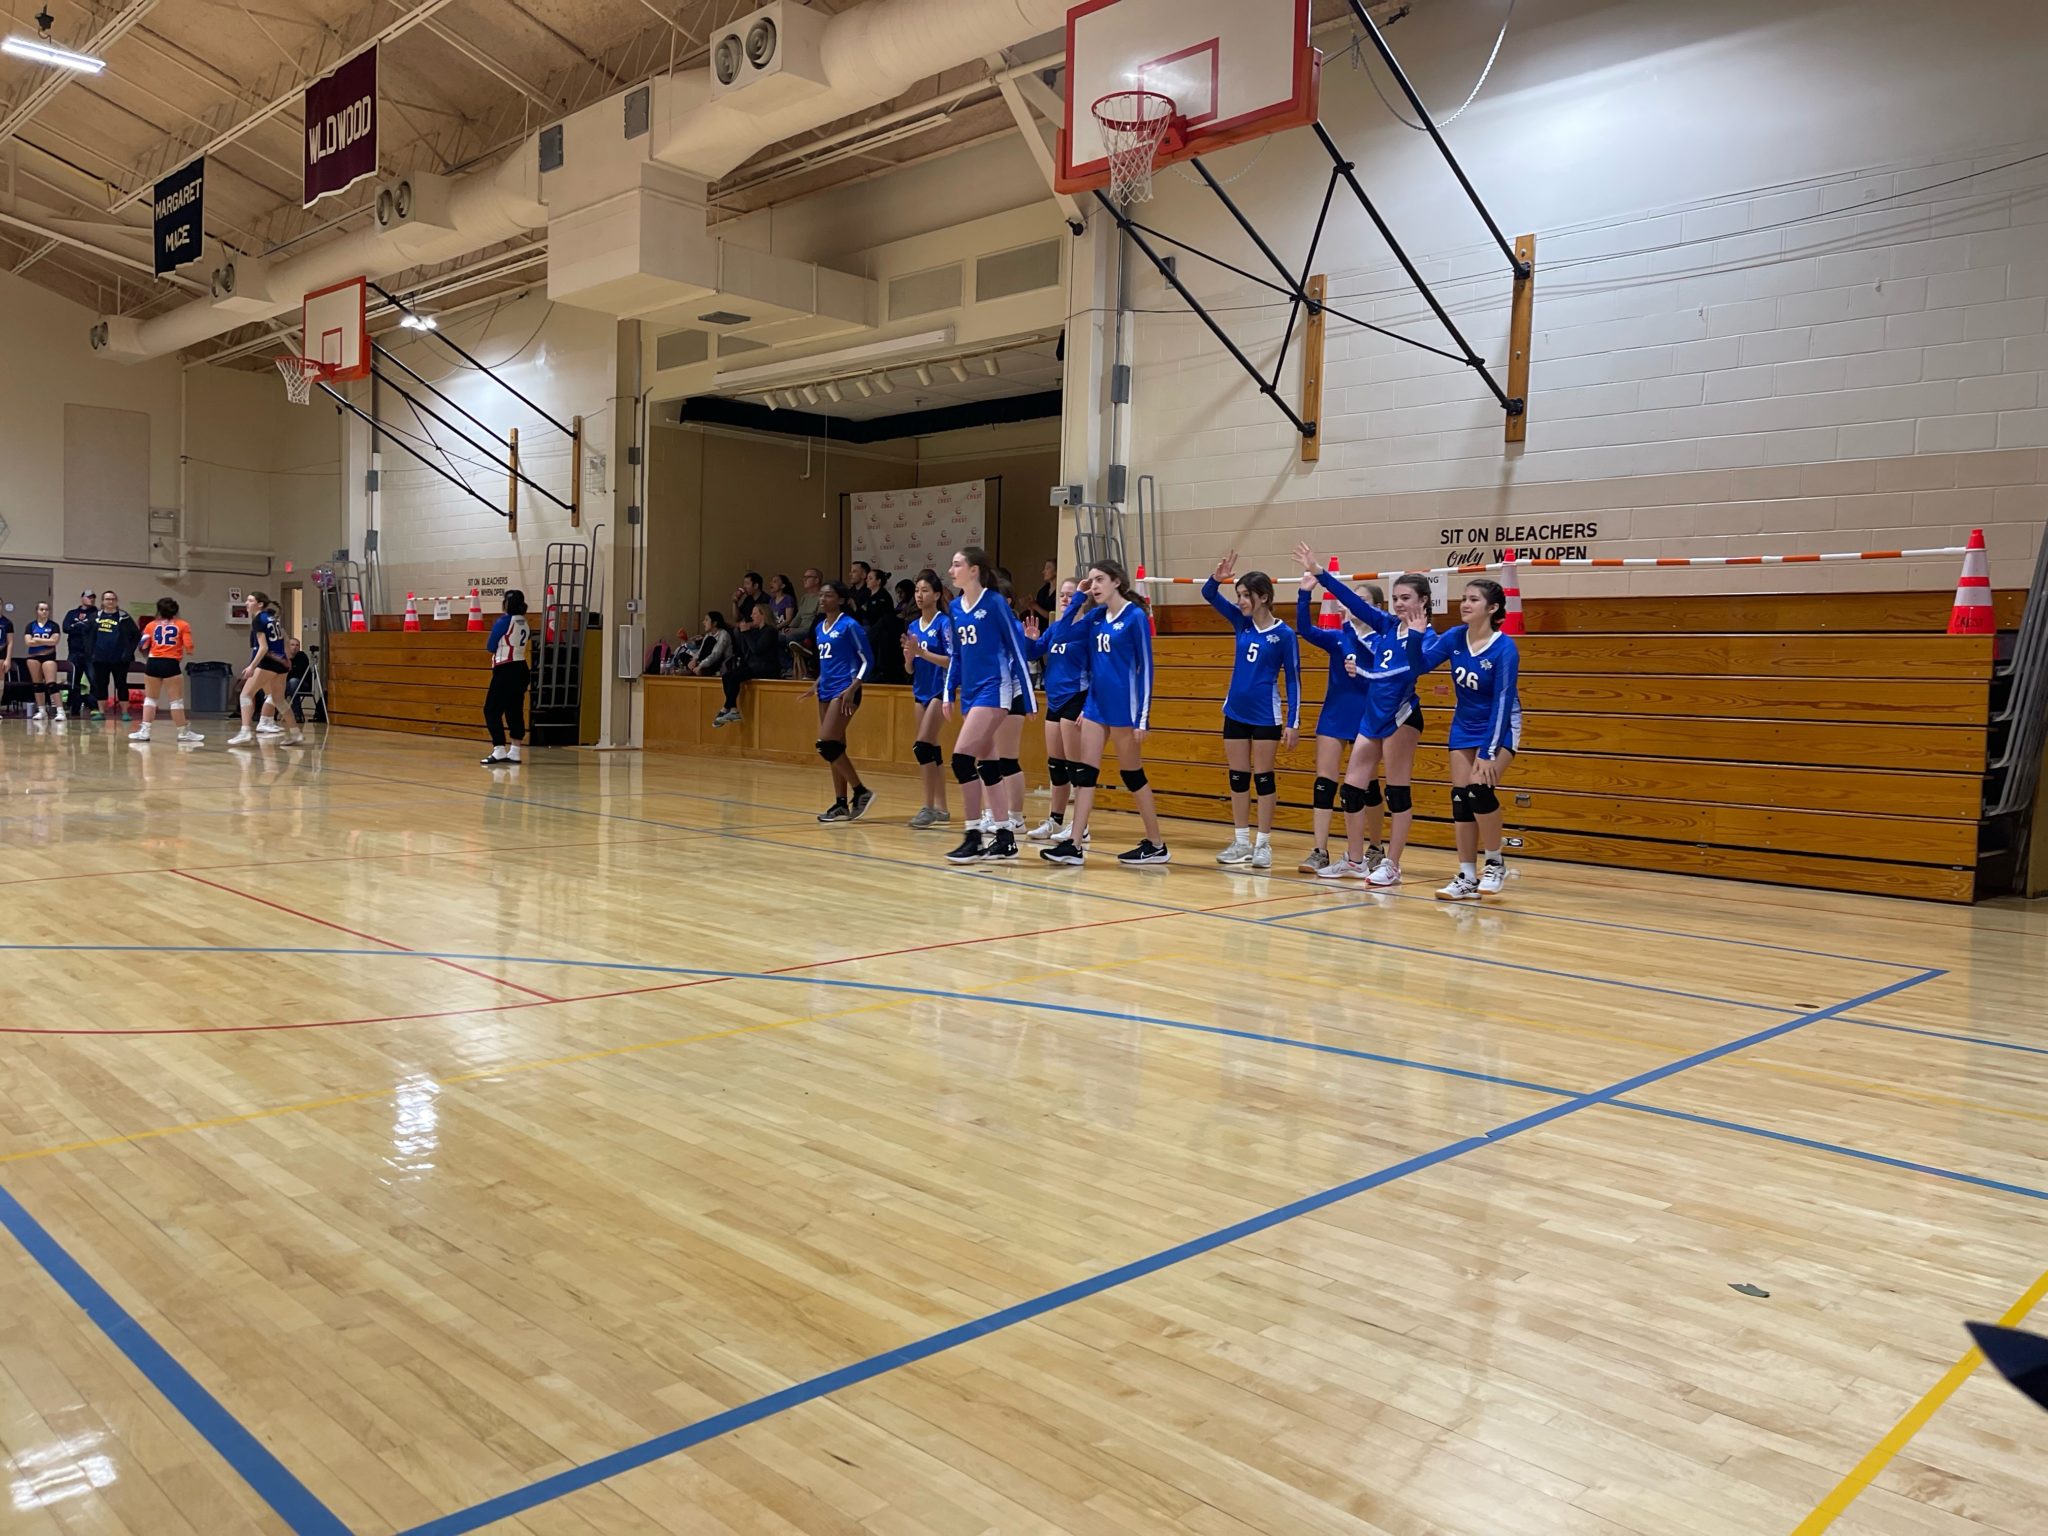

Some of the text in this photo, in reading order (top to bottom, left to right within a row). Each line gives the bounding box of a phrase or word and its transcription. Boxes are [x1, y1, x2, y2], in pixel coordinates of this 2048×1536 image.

[155, 178, 202, 220] MARGARET
[1440, 522, 1598, 544] SIT ON BLEACHERS
[1447, 547, 1484, 567] Only
[1545, 546, 1587, 560] OPEN
[481, 576, 508, 586] BLEACHERS
[153, 624, 179, 646] 42
[958, 624, 978, 646] 33
[1096, 633, 1112, 653] 18
[818, 642, 833, 660] 22
[1246, 642, 1260, 663] 5
[1380, 649, 1393, 669] 2
[1455, 666, 1480, 690] 26
